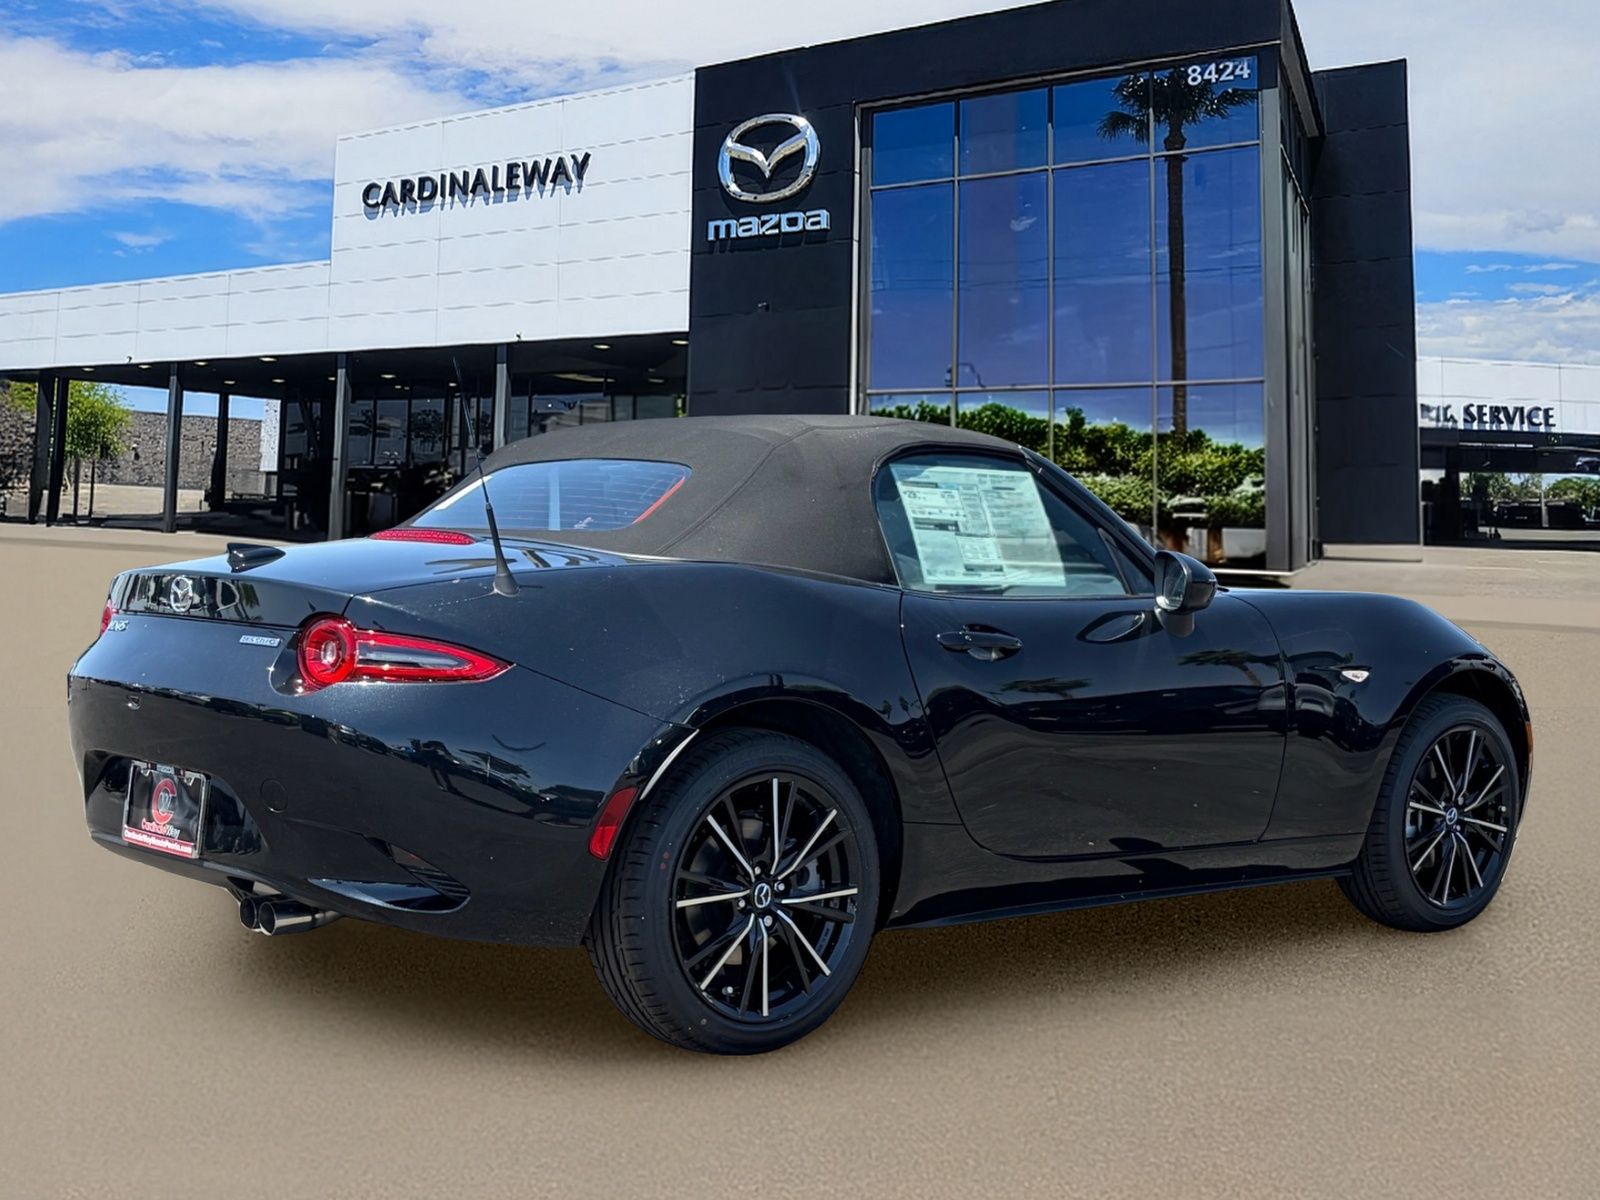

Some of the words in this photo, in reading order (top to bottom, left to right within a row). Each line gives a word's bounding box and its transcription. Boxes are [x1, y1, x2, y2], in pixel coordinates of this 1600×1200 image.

[1187, 59, 1251, 86] 8424
[362, 152, 591, 209] CARDINALEWAY
[707, 209, 830, 241] mazda
[1463, 403, 1556, 428] SERVICE
